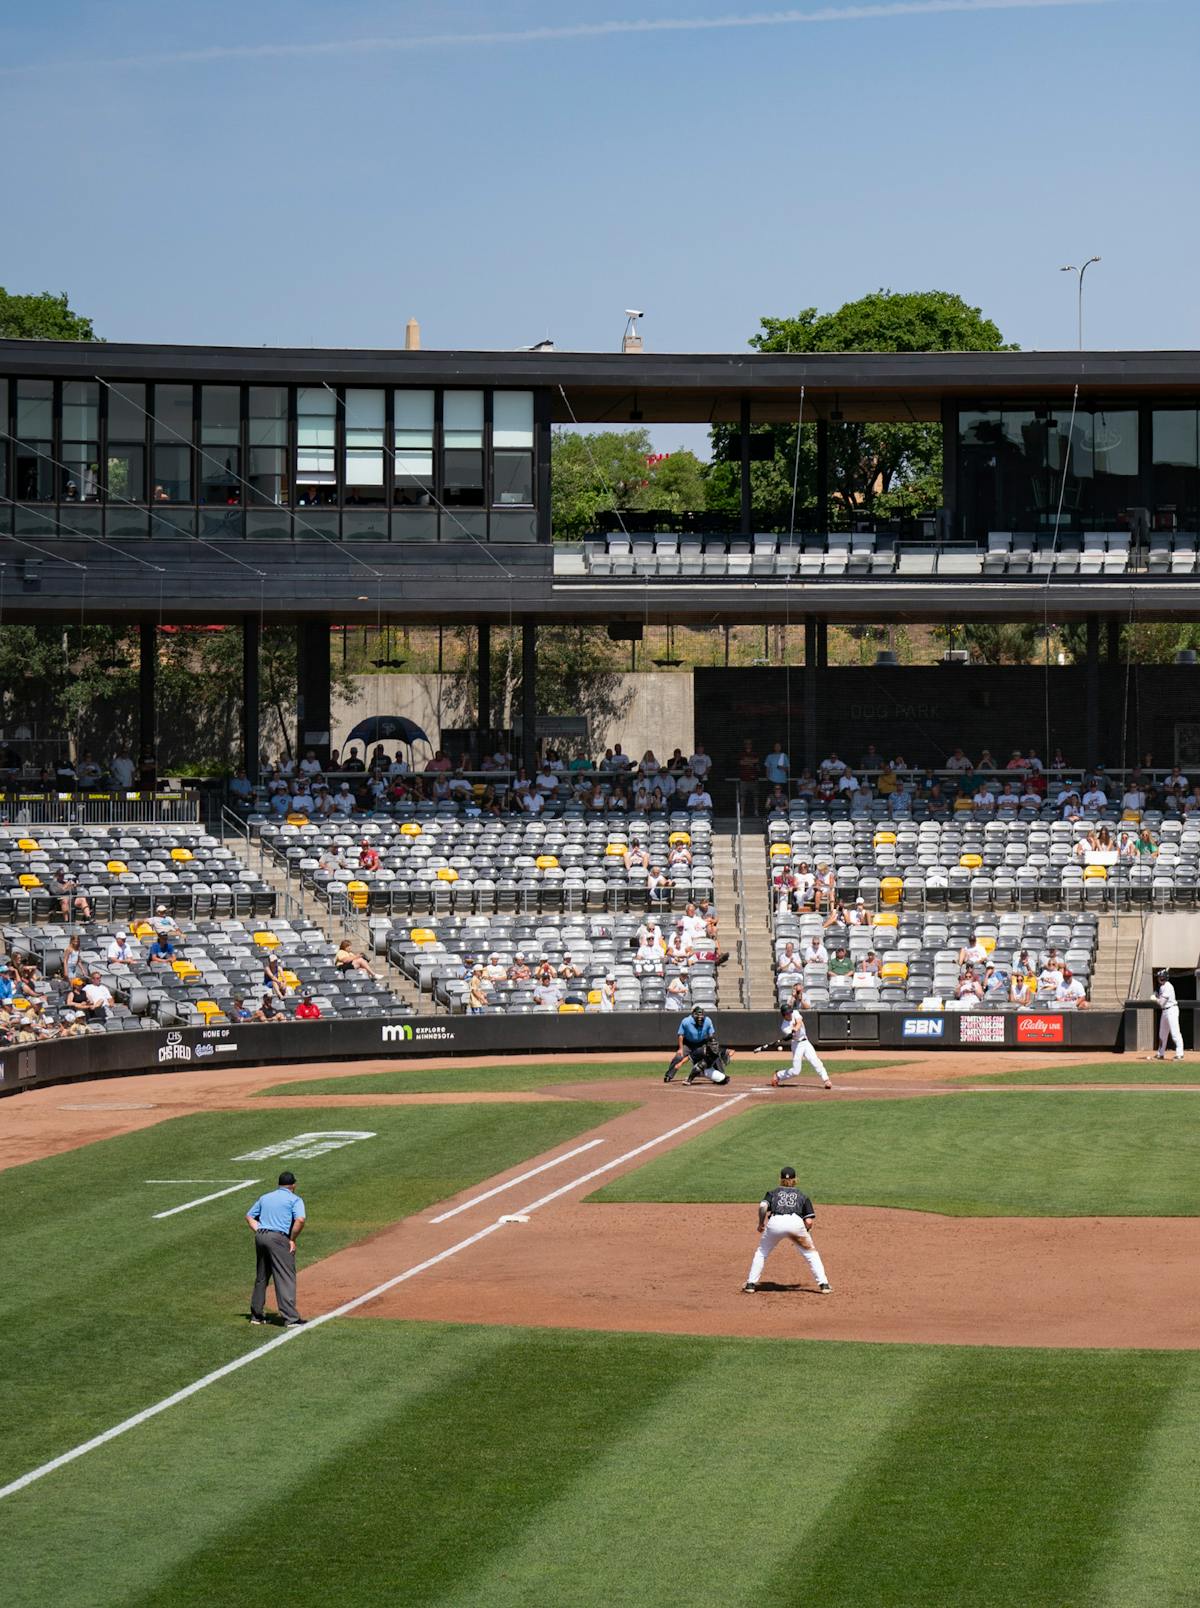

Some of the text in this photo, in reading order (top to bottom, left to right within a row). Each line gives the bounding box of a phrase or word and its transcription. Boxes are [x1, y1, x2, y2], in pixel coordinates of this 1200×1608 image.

[904, 1019, 943, 1034] SBN
[1019, 1018, 1048, 1033] Bally
[167, 1031, 181, 1040] CHS
[202, 1029, 230, 1038] HOME OF
[158, 1044, 191, 1062] CHS FIELD
[777, 1190, 798, 1207] 33
